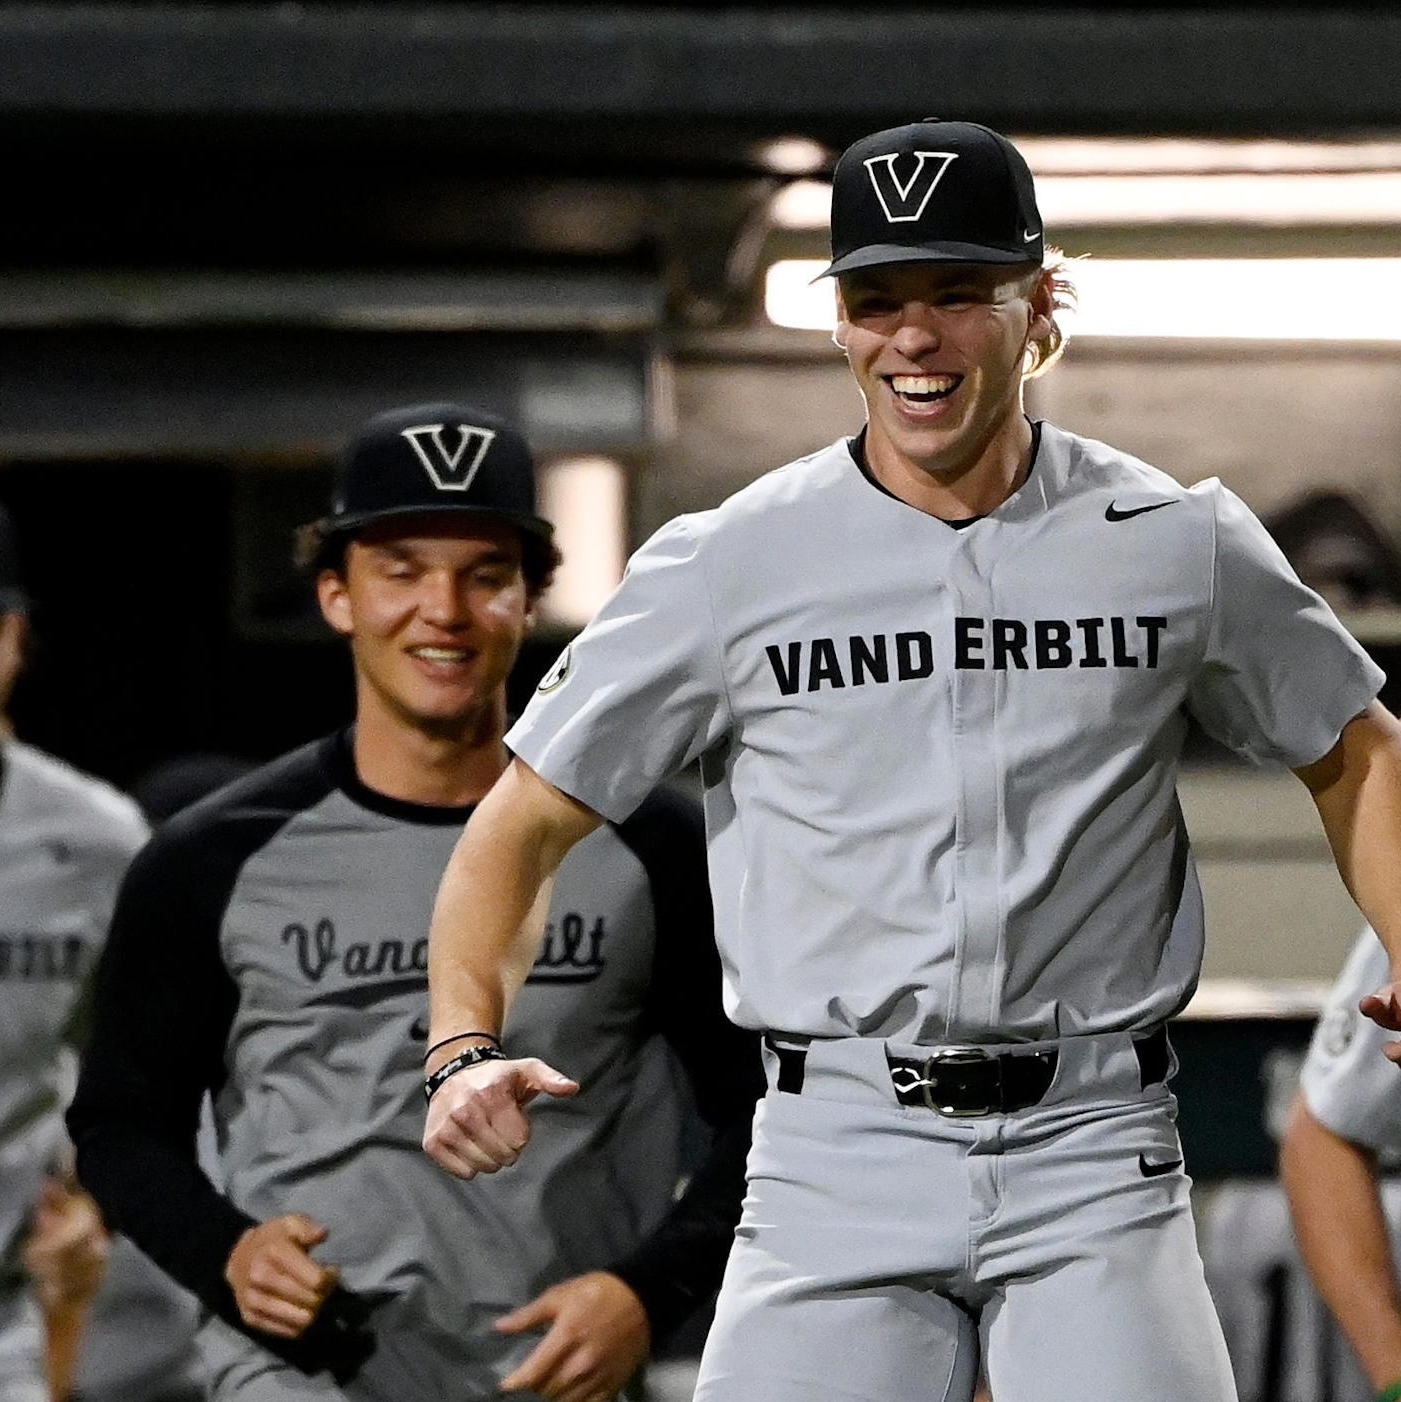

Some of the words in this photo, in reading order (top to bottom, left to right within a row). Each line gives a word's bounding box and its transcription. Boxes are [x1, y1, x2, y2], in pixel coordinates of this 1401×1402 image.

[863, 150, 959, 223] V
[401, 423, 496, 491] V
[281, 912, 606, 982] Vanilt
